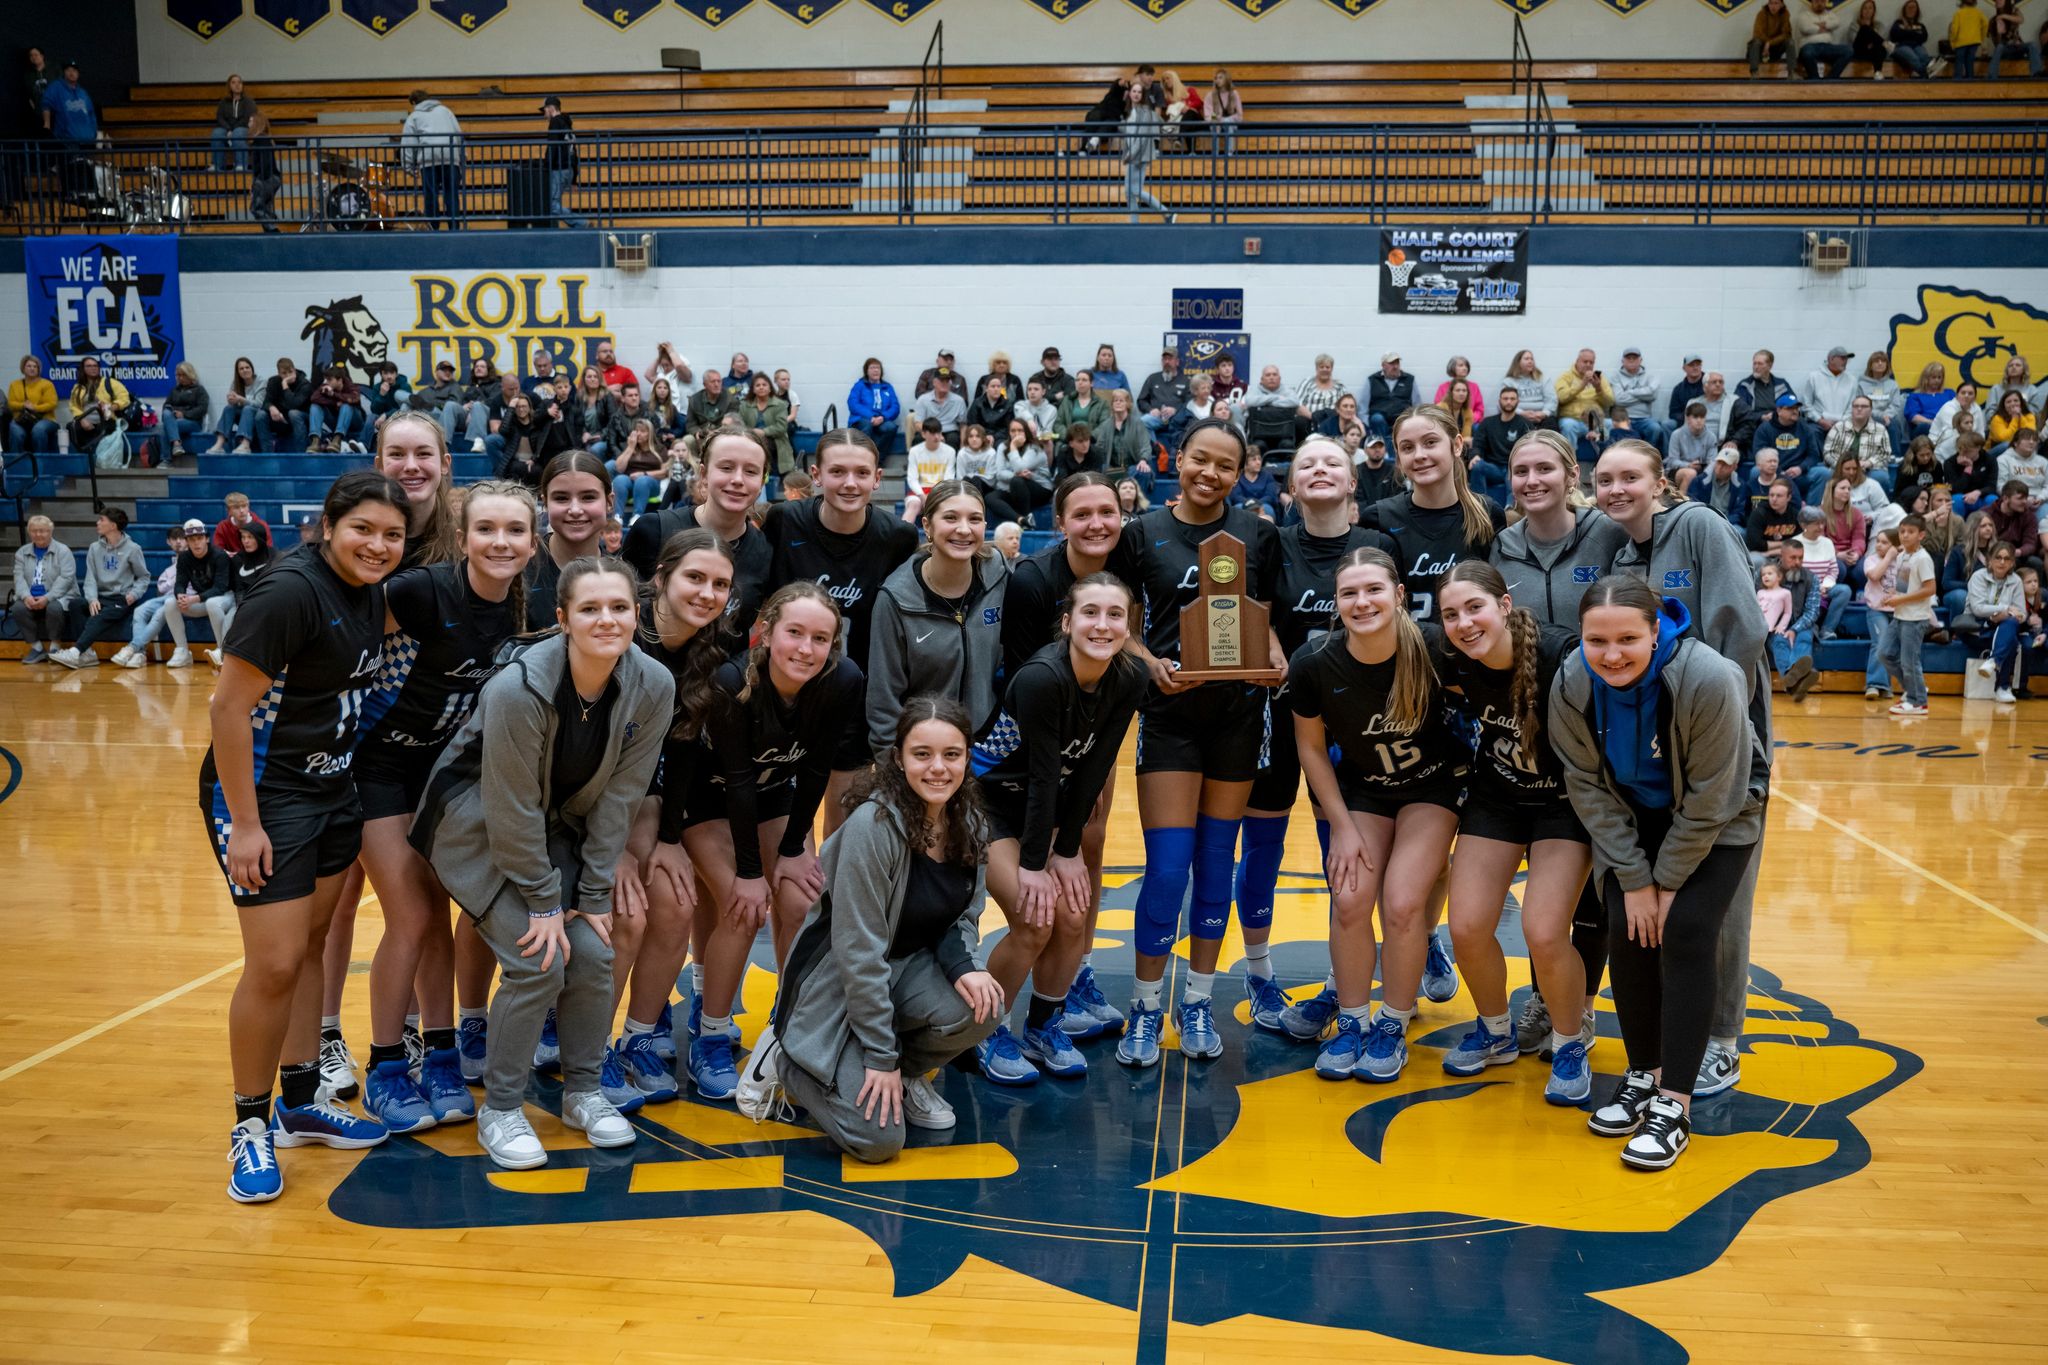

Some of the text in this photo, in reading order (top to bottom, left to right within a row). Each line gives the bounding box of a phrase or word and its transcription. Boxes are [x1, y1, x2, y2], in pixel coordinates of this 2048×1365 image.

[1392, 231, 1517, 247] HALF COURT
[1420, 250, 1514, 262] CHALLENGE
[61, 256, 138, 281] WE ARE
[411, 274, 604, 331] ROLL
[1172, 299, 1243, 319] HOME
[56, 286, 152, 350] FCA
[49, 368, 76, 380] GRANT
[115, 368, 134, 380] HIGH
[135, 367, 169, 380] SCHOOL
[1408, 553, 1457, 577] Lad
[1573, 566, 1600, 584] SK
[1663, 569, 1693, 589] SK
[1375, 739, 1421, 774] 15
